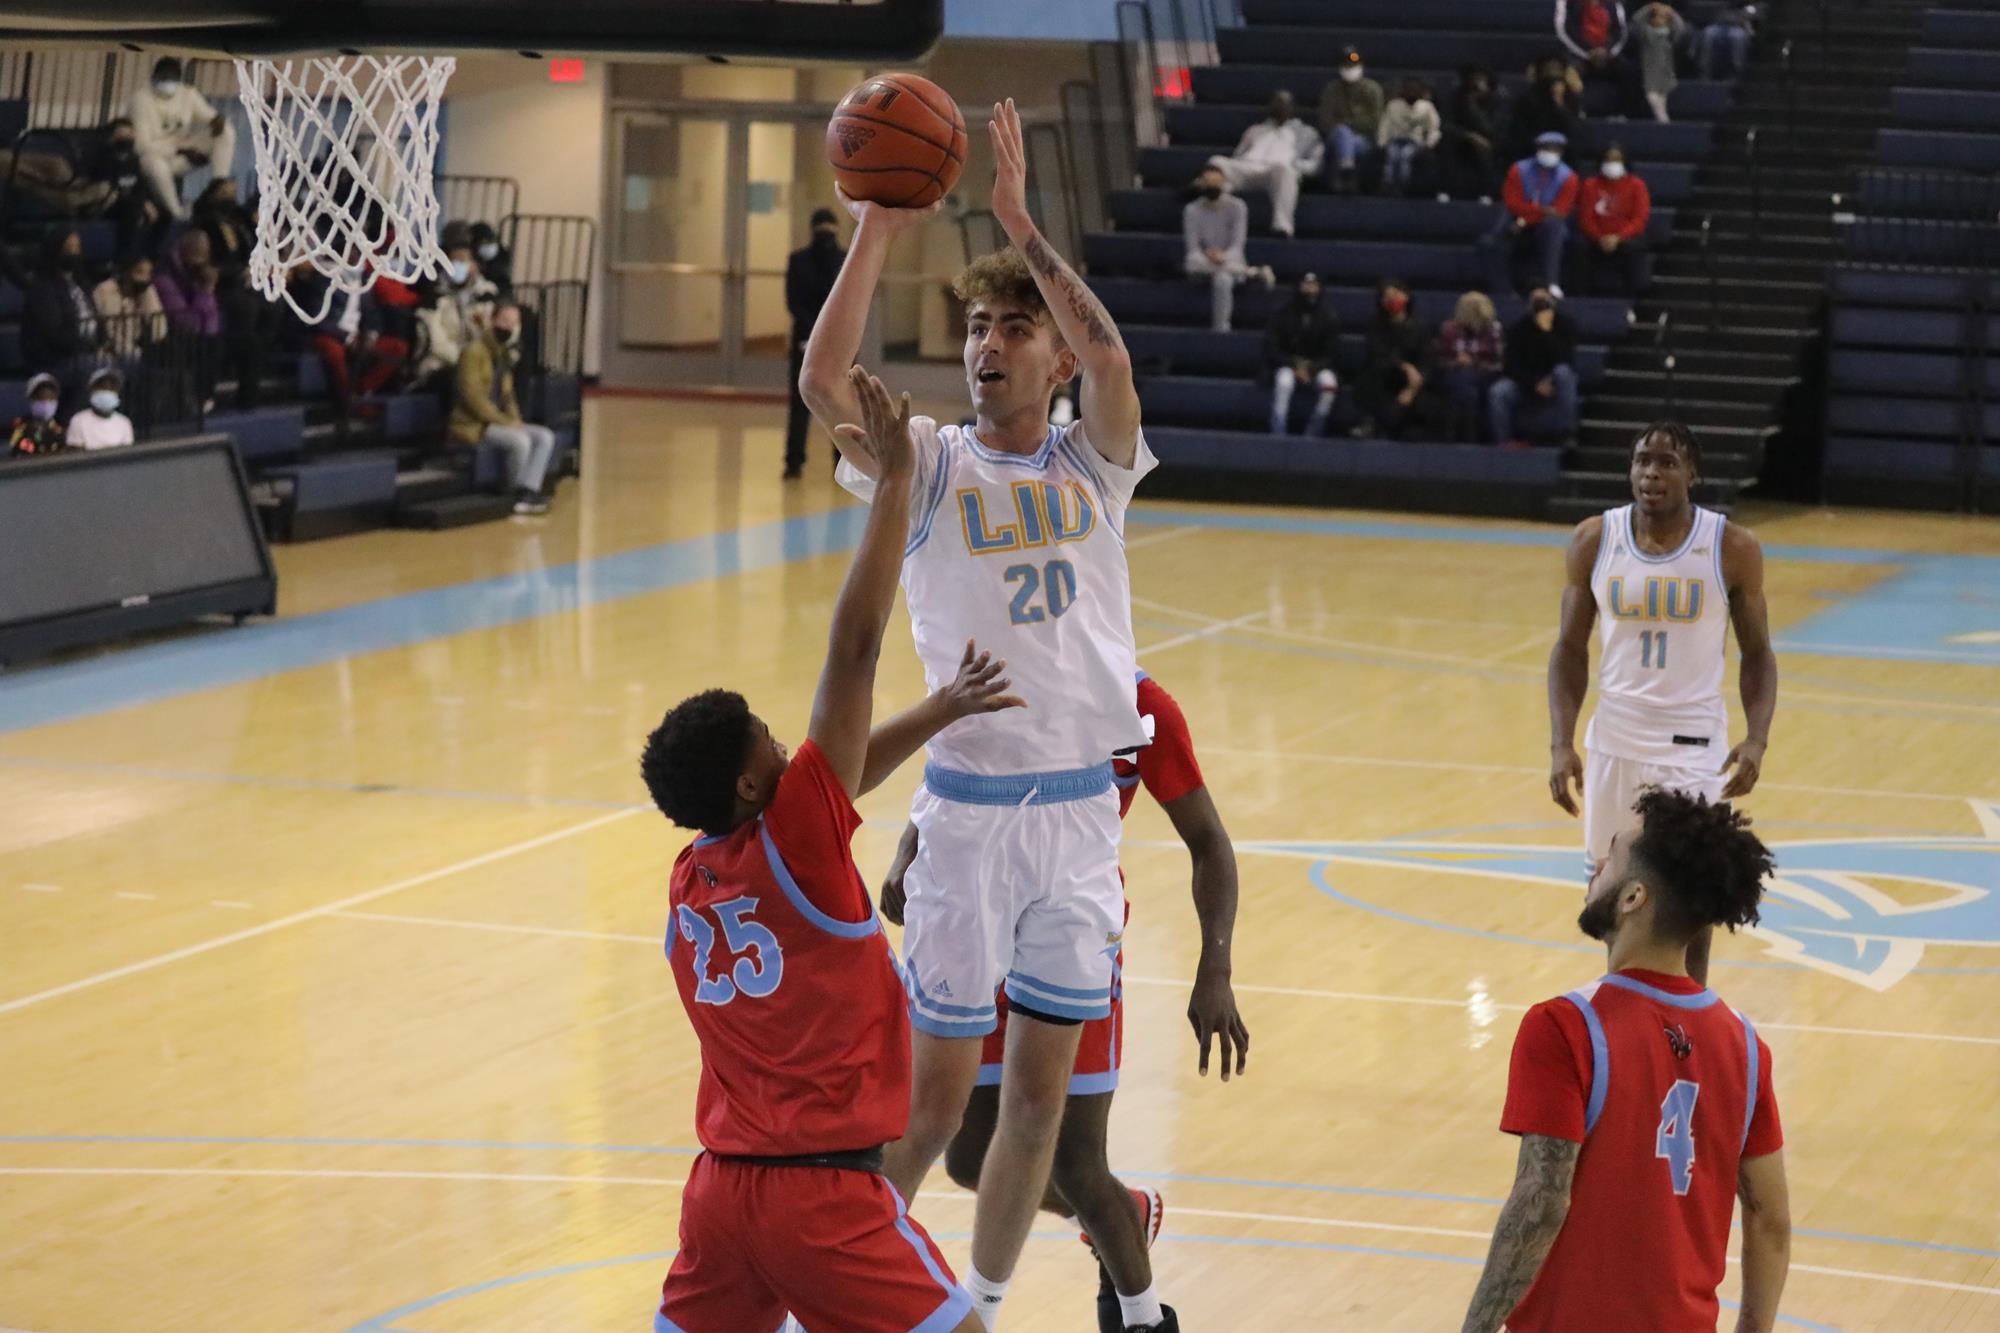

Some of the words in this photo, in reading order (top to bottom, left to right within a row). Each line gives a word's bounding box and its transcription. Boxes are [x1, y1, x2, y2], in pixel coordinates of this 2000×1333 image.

[956, 479, 1097, 556] LIU
[1004, 559, 1077, 625] 20
[1607, 576, 1704, 624] LIU
[1640, 630, 1667, 669] 11
[677, 895, 783, 1006] 25
[1655, 1079, 1699, 1196] 4
